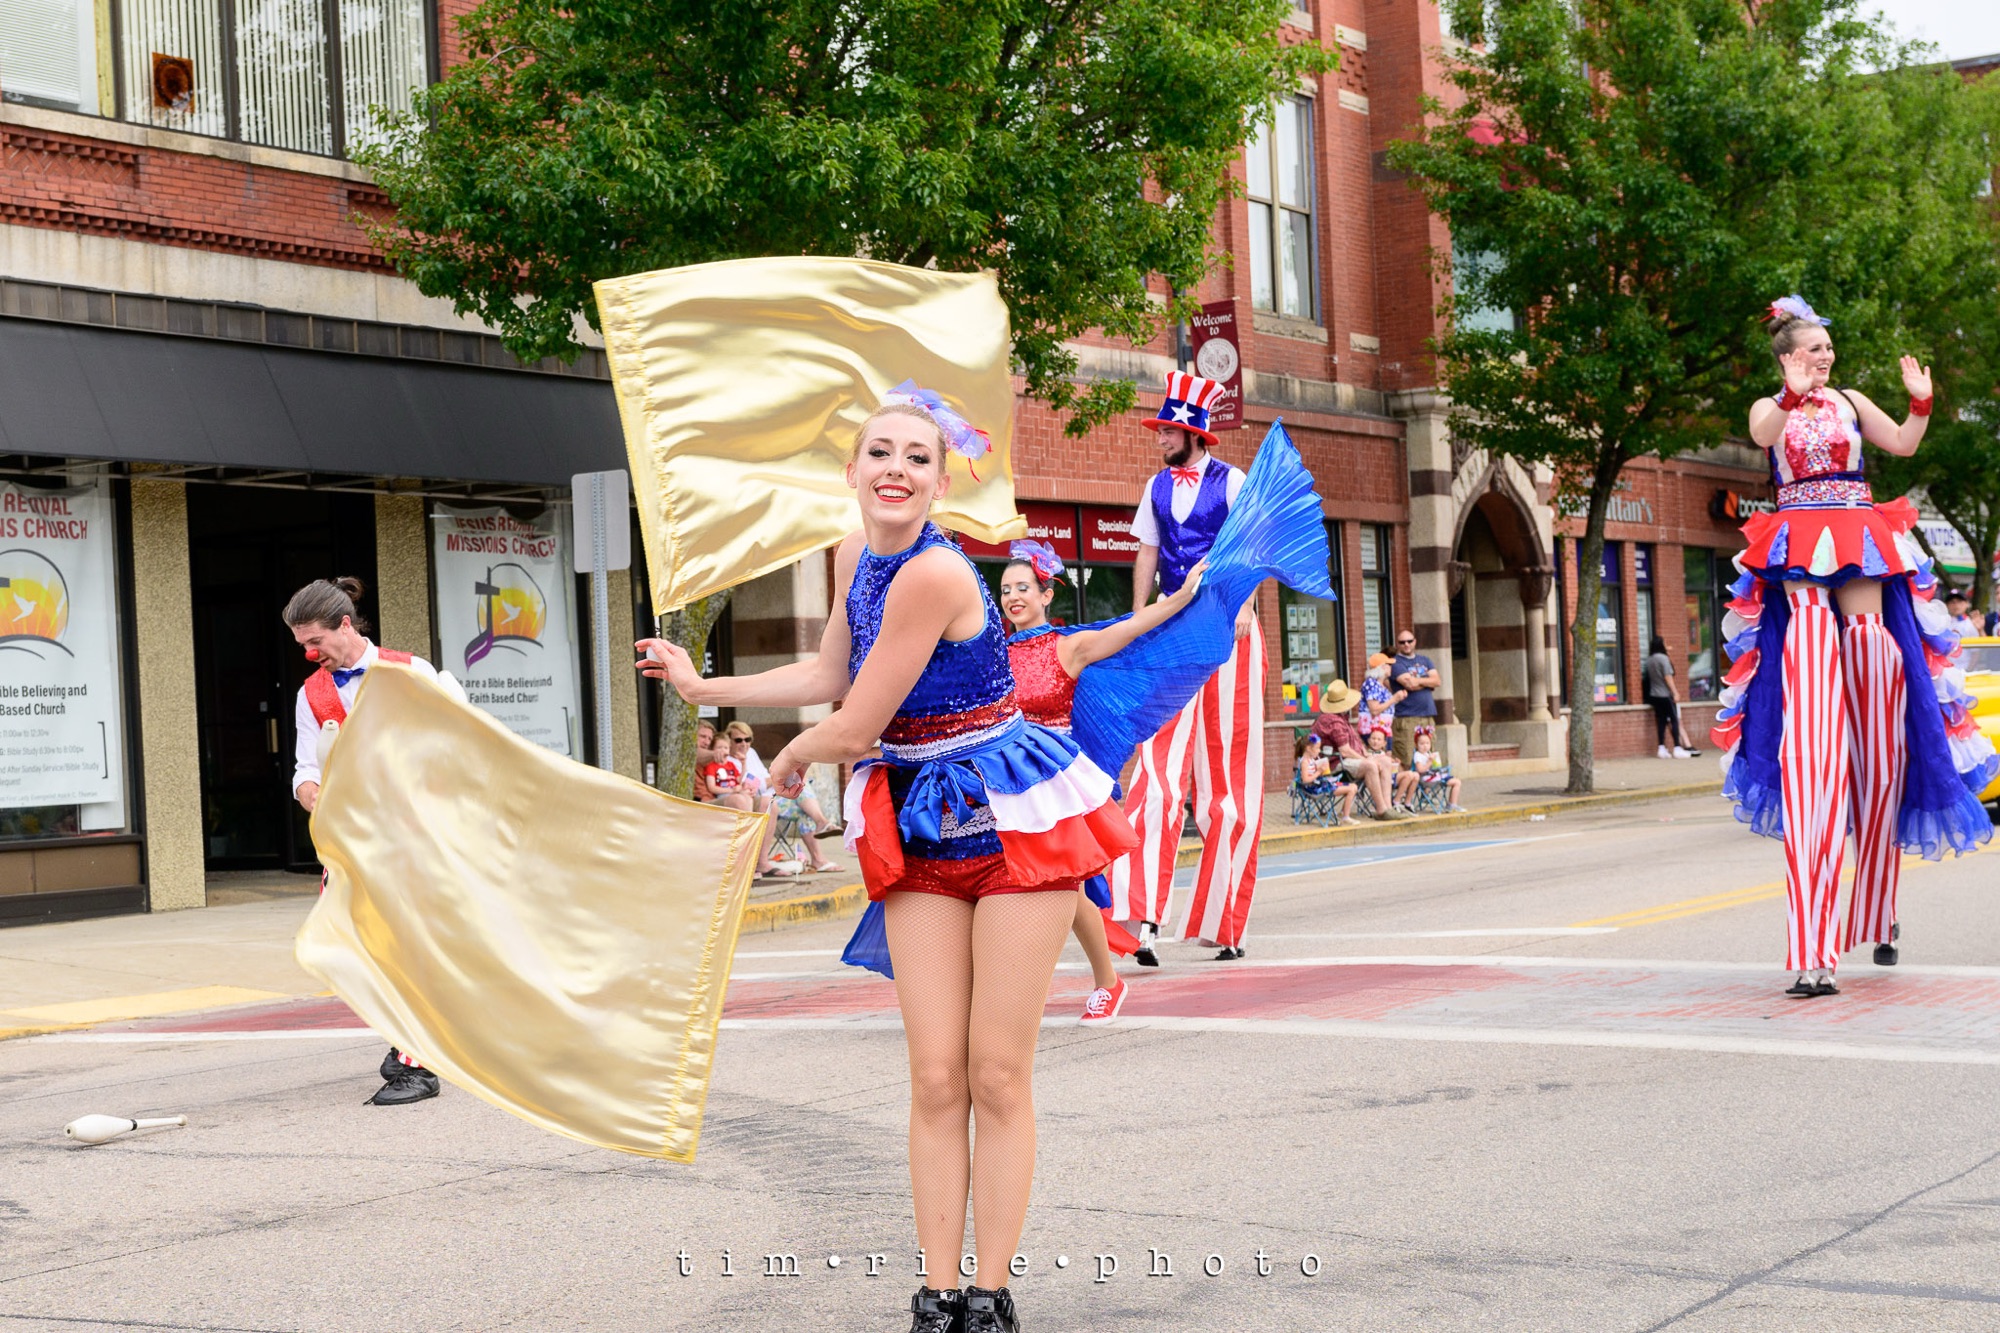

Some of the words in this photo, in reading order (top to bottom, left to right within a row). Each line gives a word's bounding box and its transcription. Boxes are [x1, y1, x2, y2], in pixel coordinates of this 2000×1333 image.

[1192, 314, 1233, 327] Welcome
[1210, 327, 1220, 335] to
[24, 518, 88, 539] CHURCH
[1054, 526, 1072, 539] Land
[1097, 519, 1131, 533] Specializin
[447, 533, 508, 554] MISSIONS
[1092, 538, 1108, 550] New
[1108, 539, 1140, 551] Construct
[465, 679, 482, 688] are
[488, 678, 505, 688] Bible
[22, 684, 66, 699] Believing
[68, 684, 87, 696] and
[469, 692, 490, 703] Faith
[492, 692, 515, 703] Based
[34, 702, 66, 715] Church
